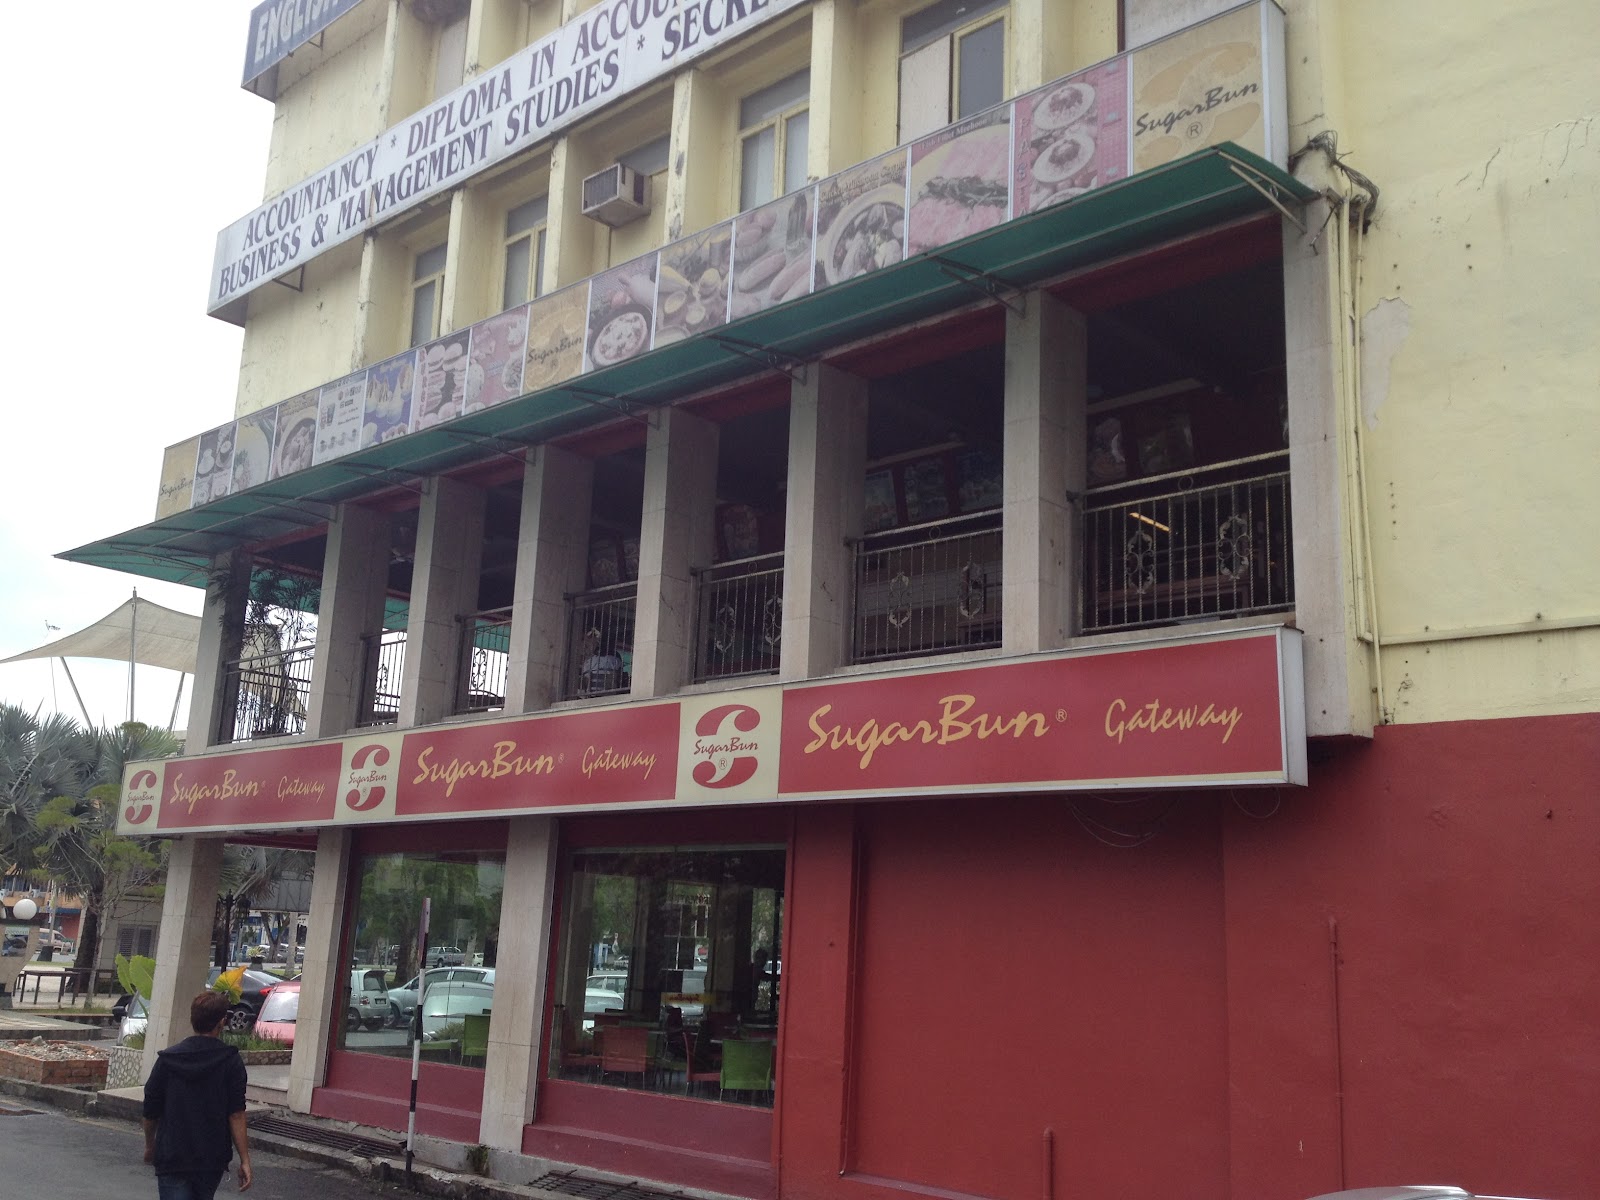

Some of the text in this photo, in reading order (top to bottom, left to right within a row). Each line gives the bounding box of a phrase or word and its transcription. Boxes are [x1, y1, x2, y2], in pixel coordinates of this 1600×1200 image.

[255, 0, 338, 63] ENGLIS
[242, 0, 680, 251] ACCOUNTANCY DIPLOMA IN ACCOU
[1135, 82, 1259, 137] SugarBun
[218, 225, 301, 300] BUSINESS
[311, 212, 328, 248] &
[337, 120, 493, 235] MANAGEMENT
[505, 48, 619, 146] STUDIES
[527, 336, 582, 365] SugarBun
[694, 736, 759, 760] SugarBun
[804, 694, 1051, 770] SugarBun
[1105, 698, 1243, 744] Gateway
[170, 769, 325, 815] SugarBun Gateway
[348, 770, 388, 788] SugarBun
[413, 740, 555, 798] SugarBun
[581, 745, 657, 780] Gateway
